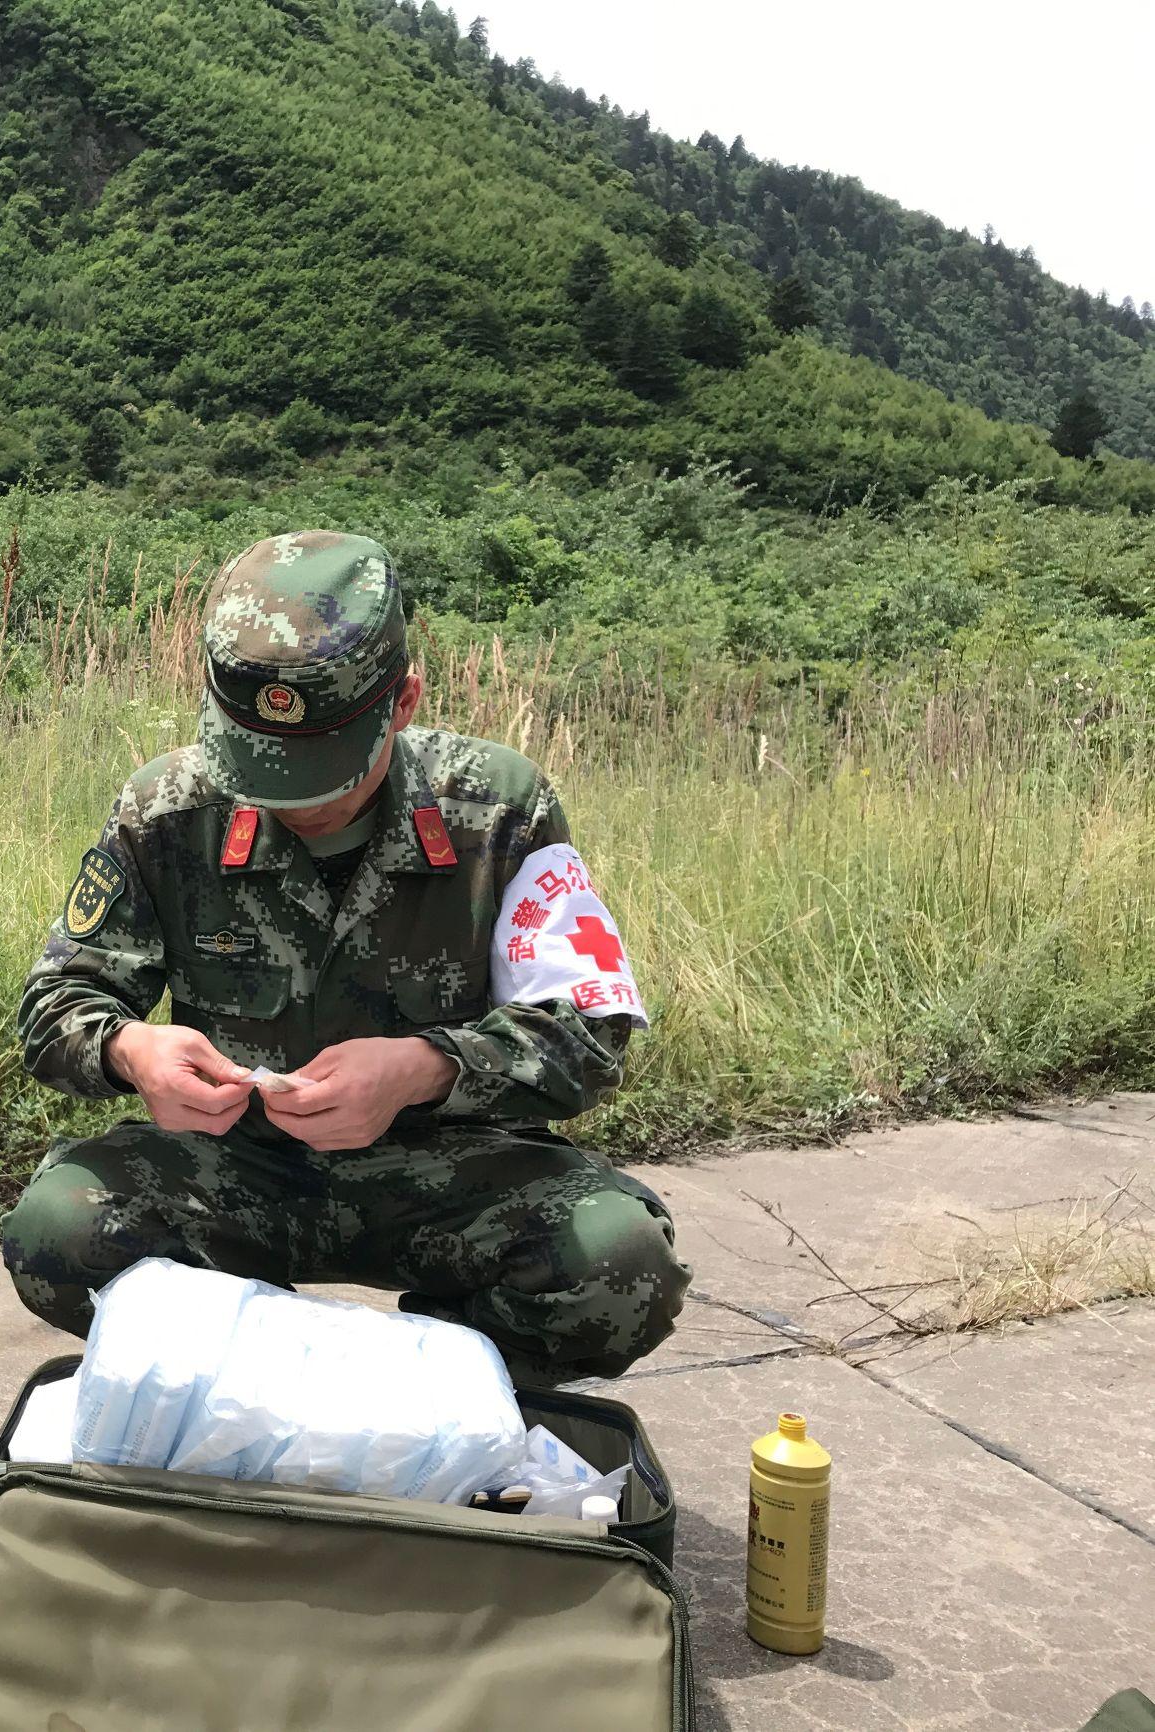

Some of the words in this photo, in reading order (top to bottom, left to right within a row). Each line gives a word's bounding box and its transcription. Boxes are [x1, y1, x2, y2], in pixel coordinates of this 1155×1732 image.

[89, 854, 121, 886] 中国人民
[507, 861, 599, 963] 武警马尔
[571, 980, 641, 1010] 医疗
